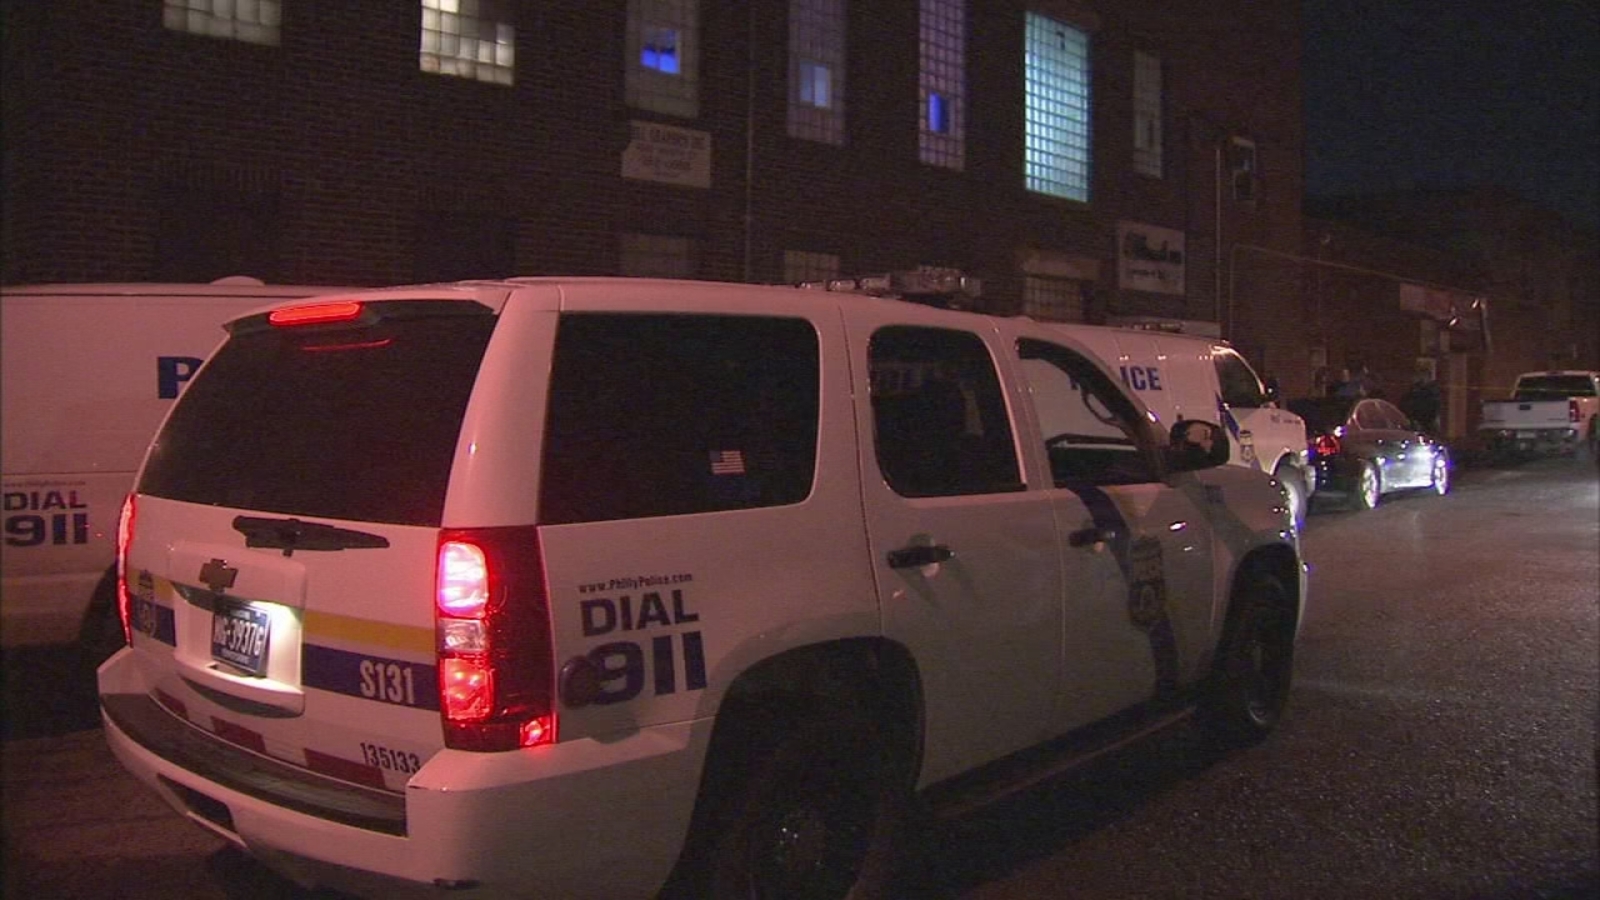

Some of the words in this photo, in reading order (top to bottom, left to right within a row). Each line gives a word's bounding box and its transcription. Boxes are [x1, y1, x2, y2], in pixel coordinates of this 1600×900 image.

[4, 490, 87, 511] DIAL
[5, 513, 87, 547] 911
[578, 573, 693, 593] www.PhillyPolice.com
[580, 589, 699, 637] DIAL
[359, 659, 415, 705] S131
[583, 631, 707, 706] 911
[360, 743, 420, 775] 135133
